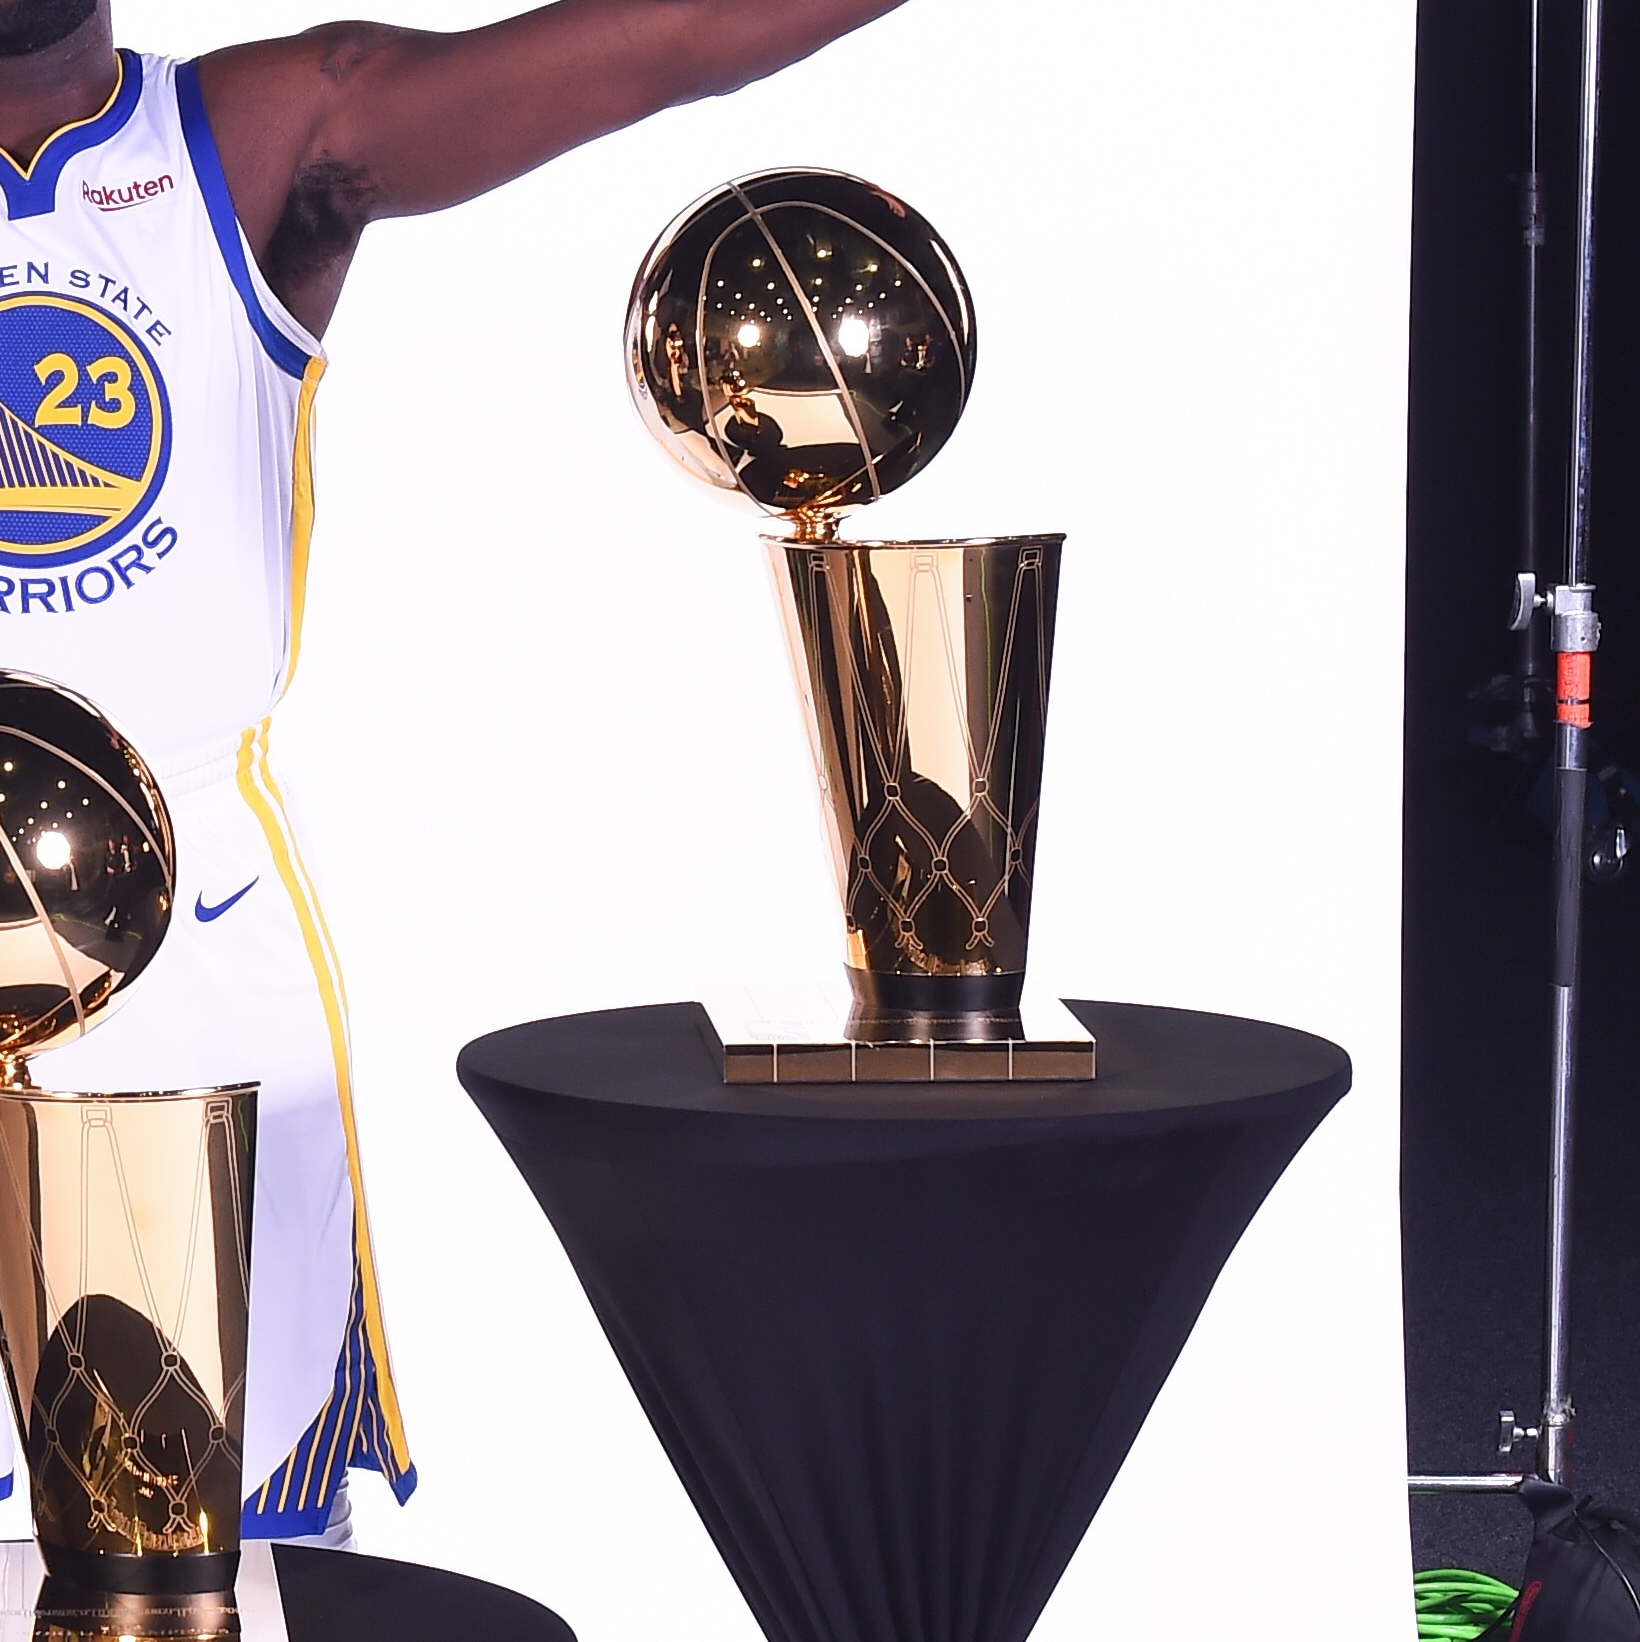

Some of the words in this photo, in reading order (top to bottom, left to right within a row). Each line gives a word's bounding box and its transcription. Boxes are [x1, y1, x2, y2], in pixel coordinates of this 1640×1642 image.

[82, 174, 174, 206] Rakuten
[68, 269, 173, 347] STATE
[33, 352, 136, 429] 23
